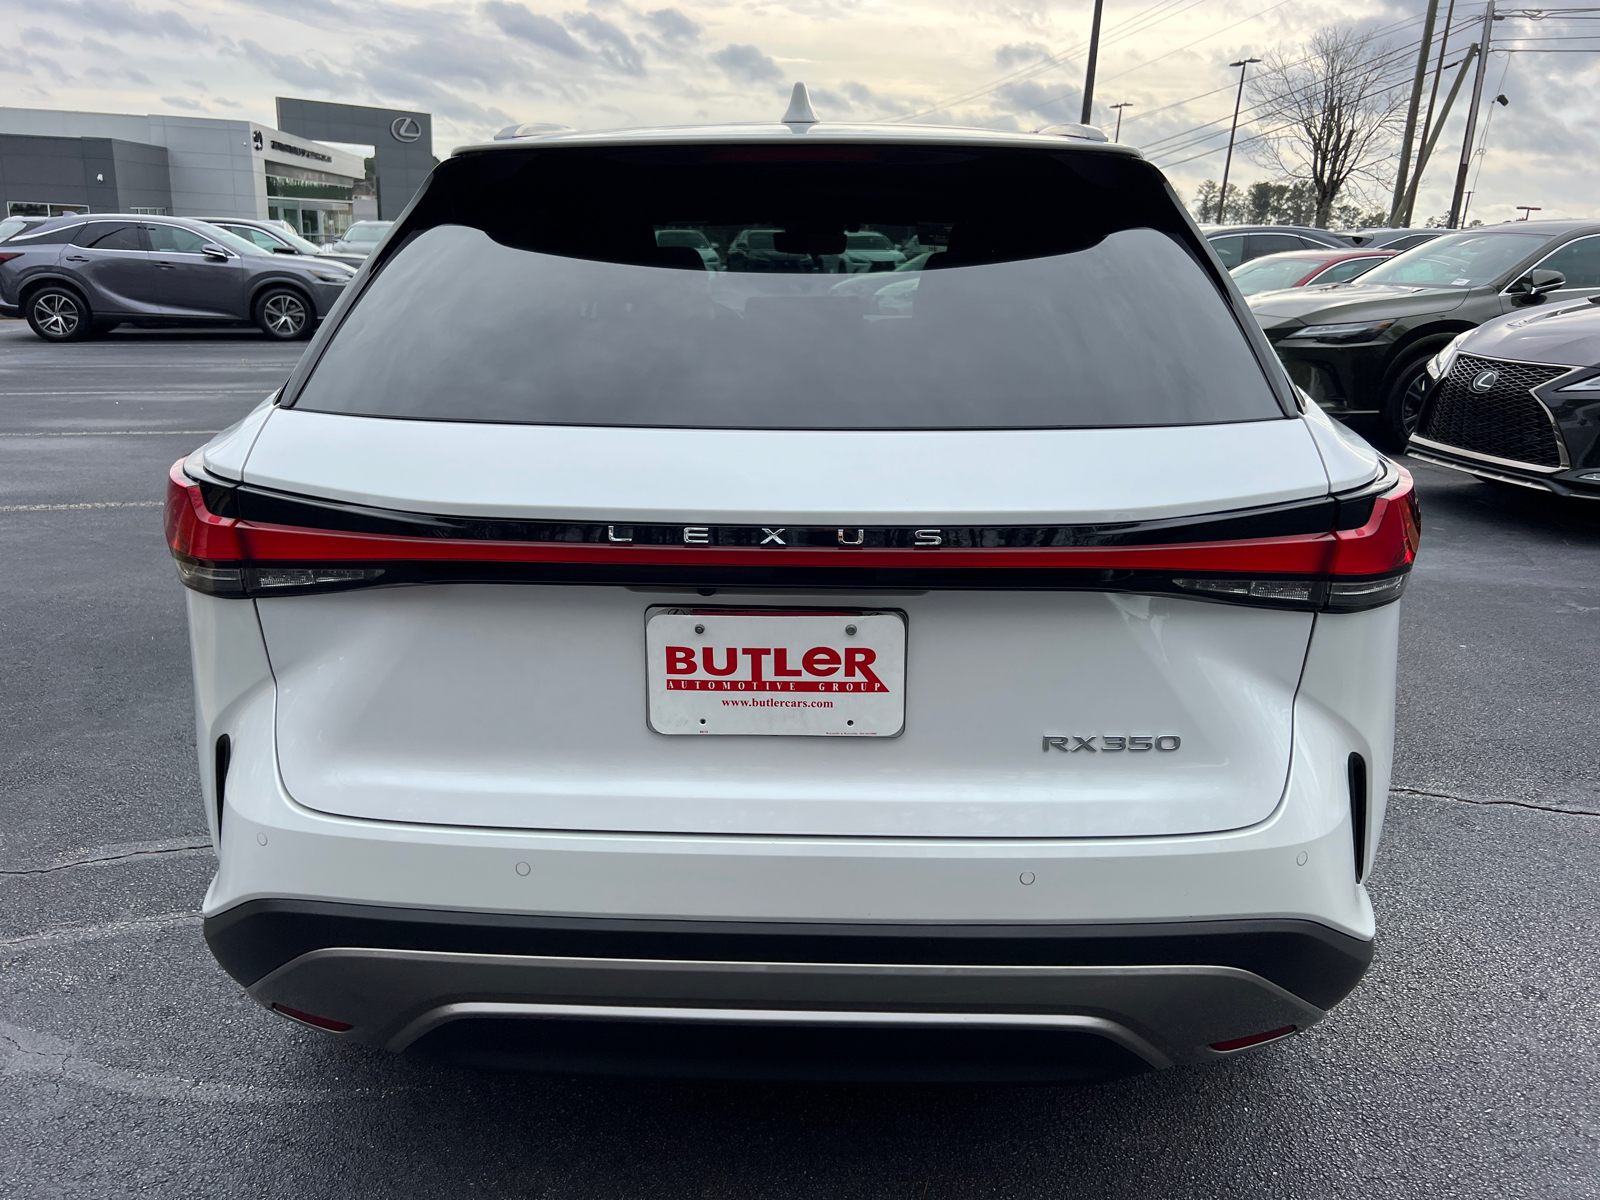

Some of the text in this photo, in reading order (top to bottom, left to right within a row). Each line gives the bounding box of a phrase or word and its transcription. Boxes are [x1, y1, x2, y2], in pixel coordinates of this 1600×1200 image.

[607, 525, 943, 547] LEXUS
[667, 680, 882, 692] AUTOMOTIVE GROUP
[721, 697, 834, 709] www.butlercars.com
